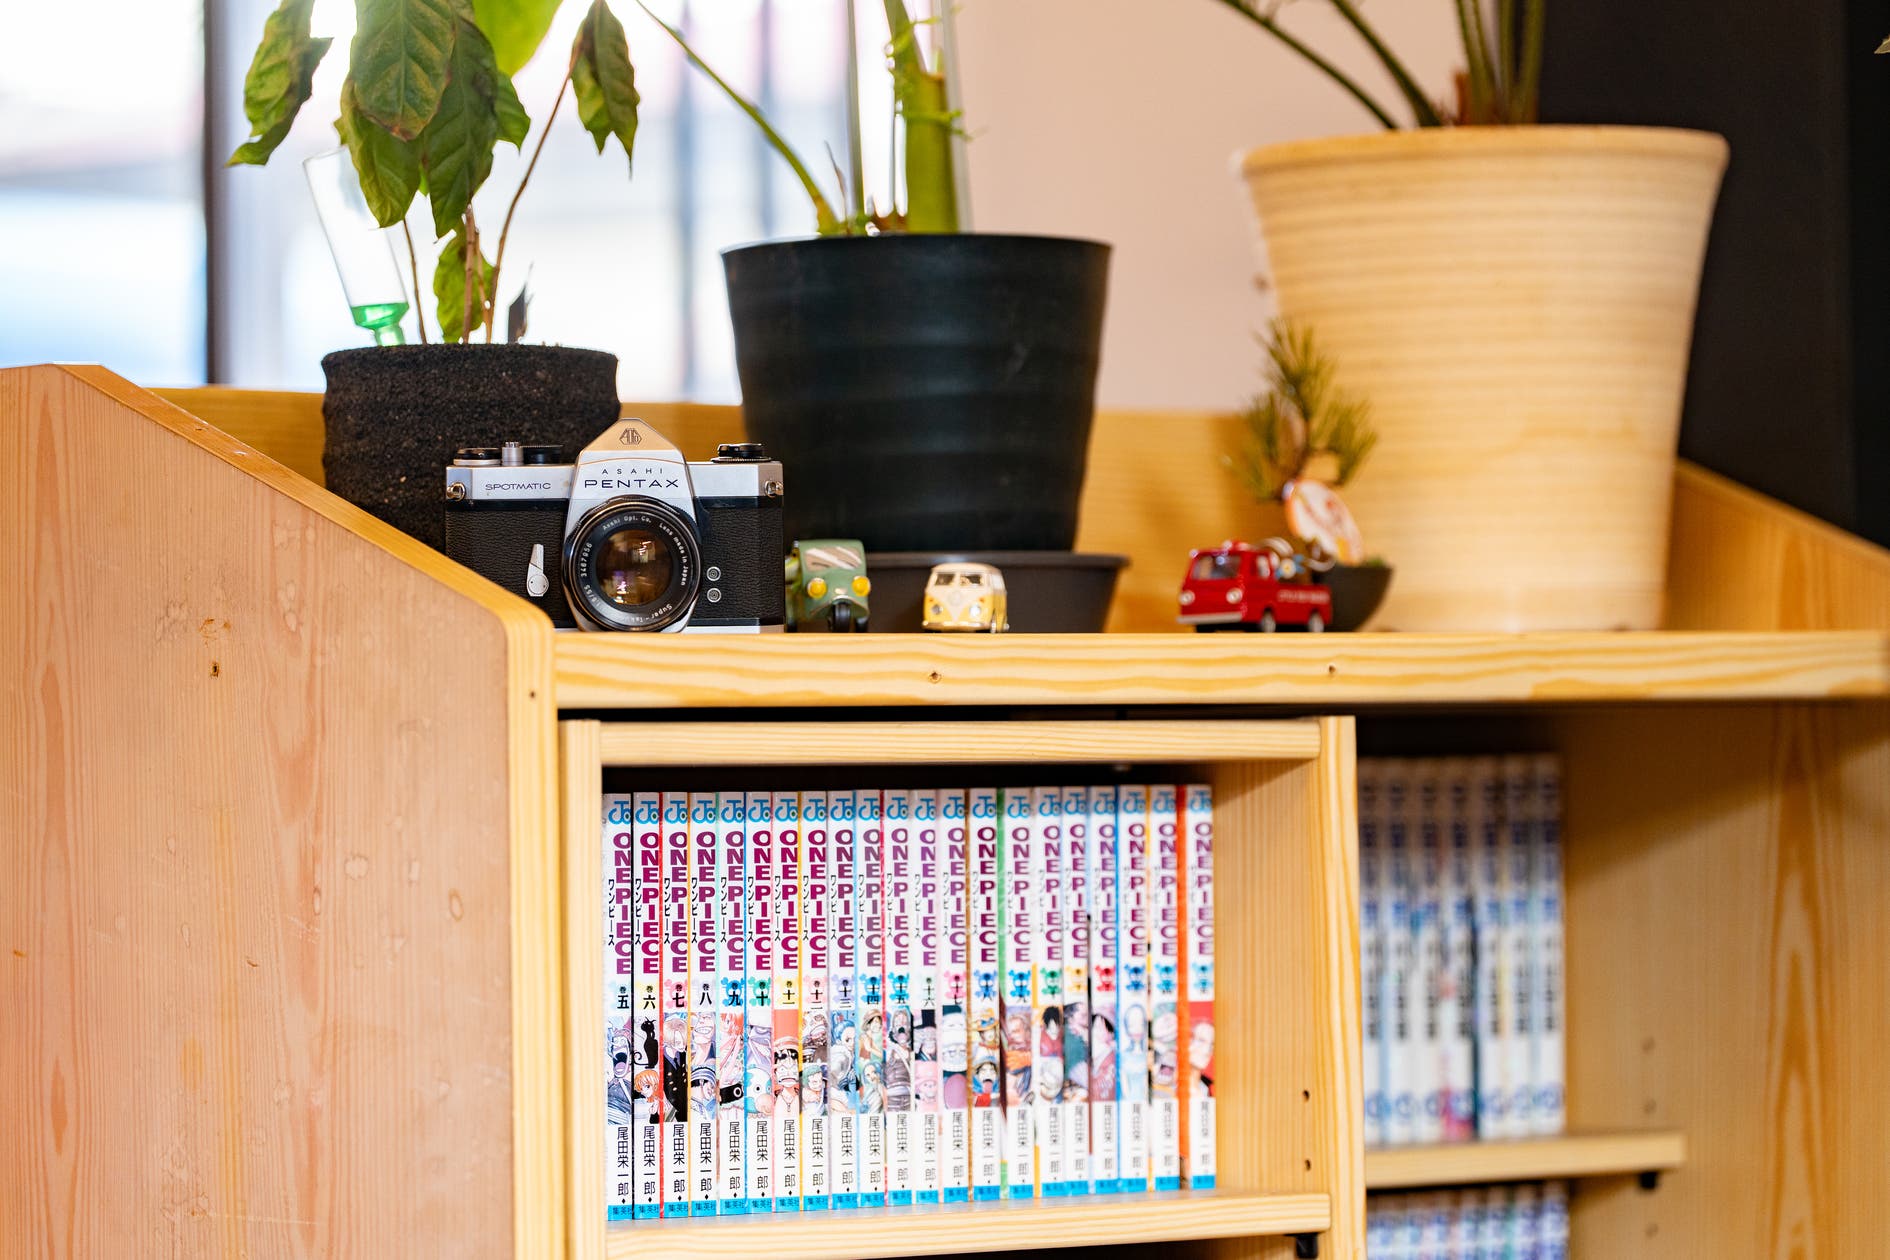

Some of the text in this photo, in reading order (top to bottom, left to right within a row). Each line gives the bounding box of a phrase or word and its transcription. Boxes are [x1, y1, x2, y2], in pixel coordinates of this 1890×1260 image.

[485, 482, 551, 491] SPOTMATIC
[584, 480, 679, 489] PENTAX
[602, 518, 620, 531] Asahi
[673, 536, 684, 554] made
[1043, 825, 1060, 873] ONE
[1070, 823, 1086, 871] ONE
[1099, 824, 1115, 872] ONE
[1128, 823, 1145, 870] ONE
[1159, 823, 1176, 869] ONE
[1195, 822, 1212, 869] ONE
[613, 832, 631, 974] ONE PIECE
[640, 832, 659, 974] ONE PIECE
[669, 831, 688, 973] ONE PIECE
[696, 831, 716, 972] ONE PIECE
[725, 831, 744, 971] ONE PIECE
[752, 830, 771, 970] ONE PIECE
[779, 830, 798, 969] ONE PIECE
[808, 829, 827, 968] ONE PIECE
[835, 829, 854, 968] ONE PIECE
[863, 828, 881, 967] ONE PIECE
[891, 828, 909, 965] ONE PIECE
[919, 829, 936, 966] ONE PIECE
[947, 827, 965, 964] ONE PIECE
[977, 827, 996, 962] ONE PIECE
[1012, 827, 1030, 962] ONE PIECE
[1045, 879, 1062, 960] PIECE
[1072, 877, 1087, 958] PIECE
[1101, 877, 1115, 958] PIECE
[1130, 876, 1146, 957] PIECE
[1161, 876, 1176, 956] PIECE
[1197, 875, 1213, 956] PIECE
[617, 1126, 629, 1196] 尾田栄一郎
[643, 1126, 656, 1195] 尾田栄一郎
[673, 1124, 685, 1193] 尾田栄一郎
[700, 1122, 712, 1192] 尾田栄一郎
[729, 1121, 741, 1191] 尾田栄一郎
[757, 1121, 768, 1190] 尾田栄一郎
[784, 1119, 795, 1188] 尾田栄一郎
[812, 1118, 824, 1186] 尾田栄一郎
[841, 1117, 853, 1184] 尾田栄一郎
[869, 1115, 881, 1183] 尾田栄一郎
